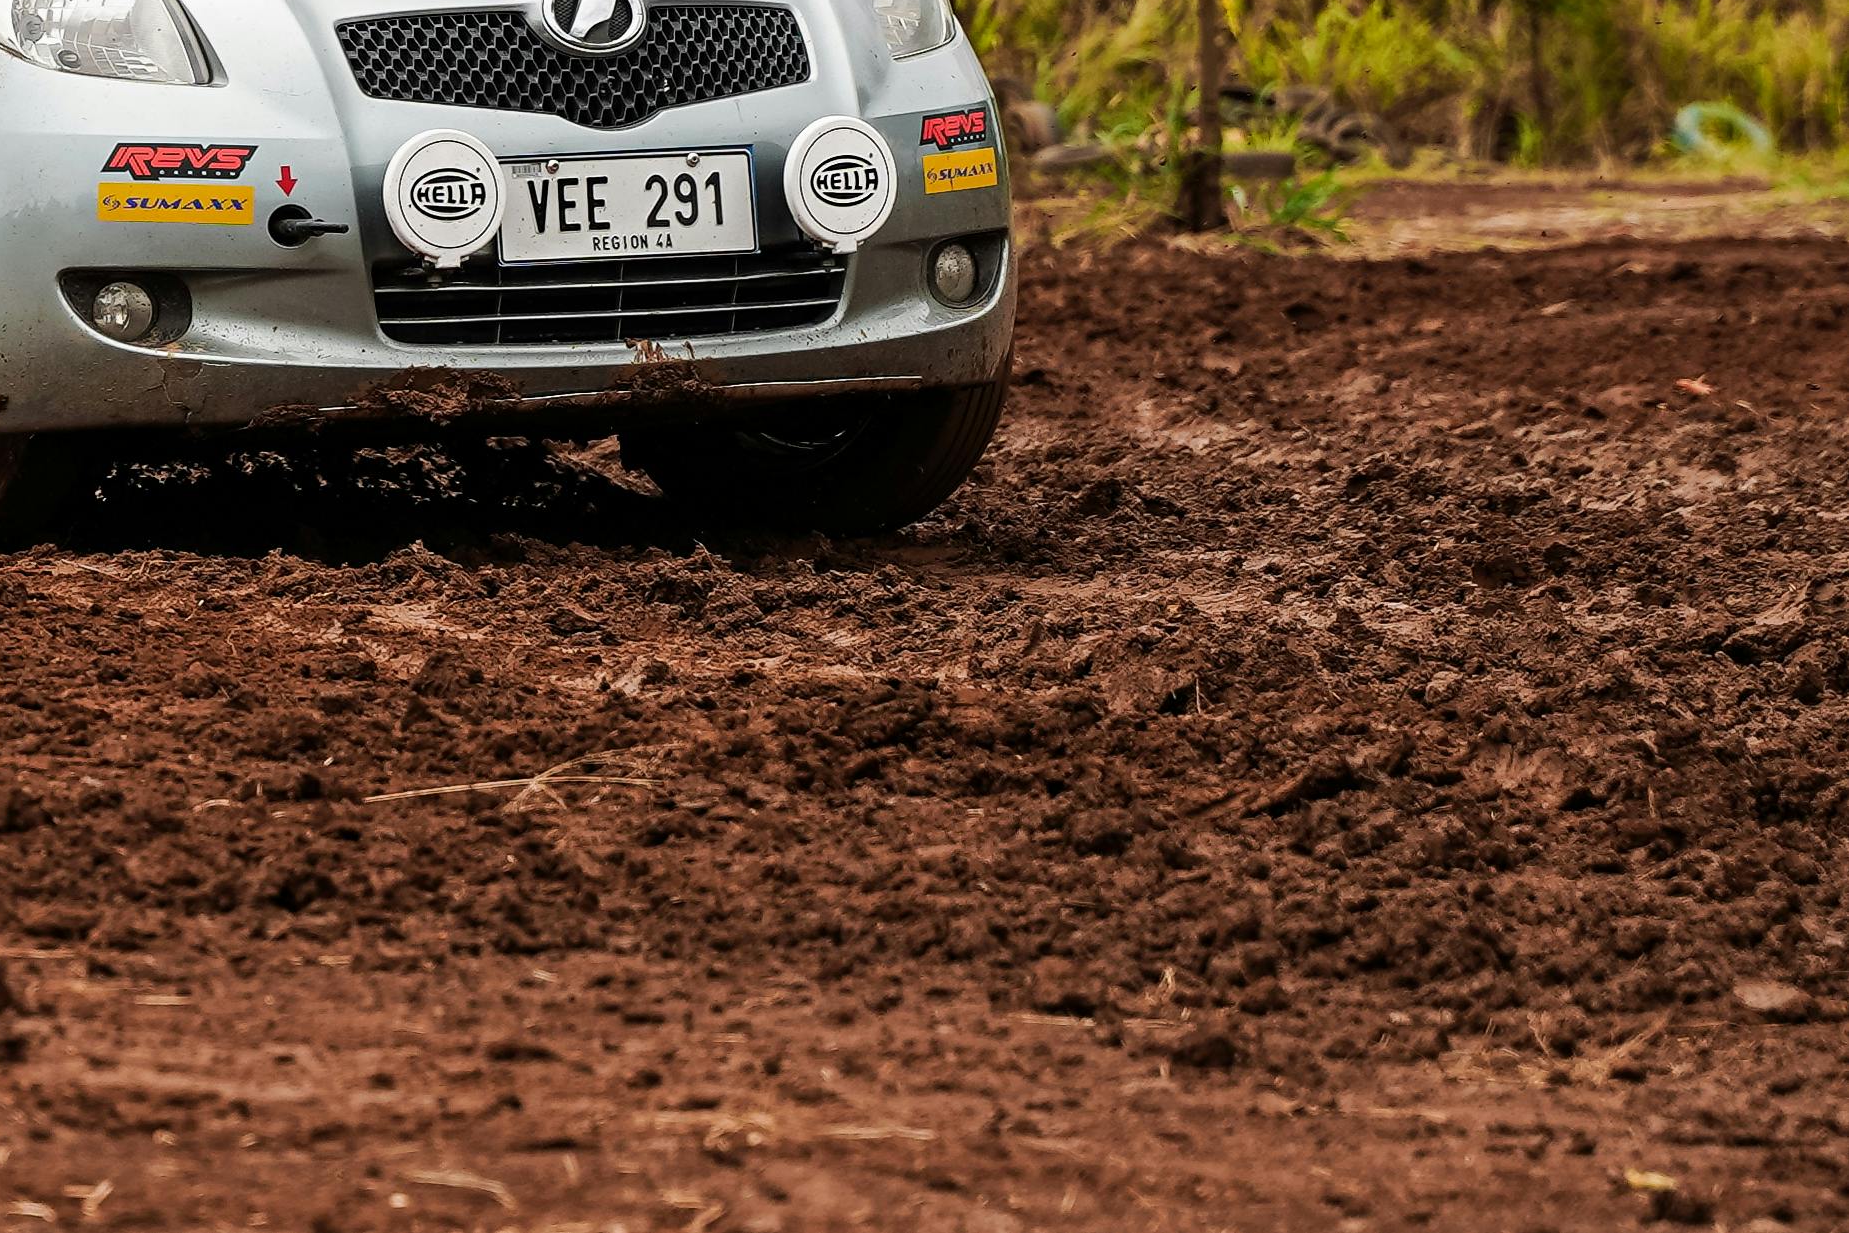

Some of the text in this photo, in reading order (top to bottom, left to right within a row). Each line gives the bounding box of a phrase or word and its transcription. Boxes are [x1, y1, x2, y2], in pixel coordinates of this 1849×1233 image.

[816, 167, 879, 190] HELLA
[937, 162, 993, 180] SUMAXX
[123, 197, 248, 210] SUMAXX
[416, 182, 486, 206] HELLA
[527, 171, 724, 234] VEE 291
[592, 234, 673, 251] REGION 4A
